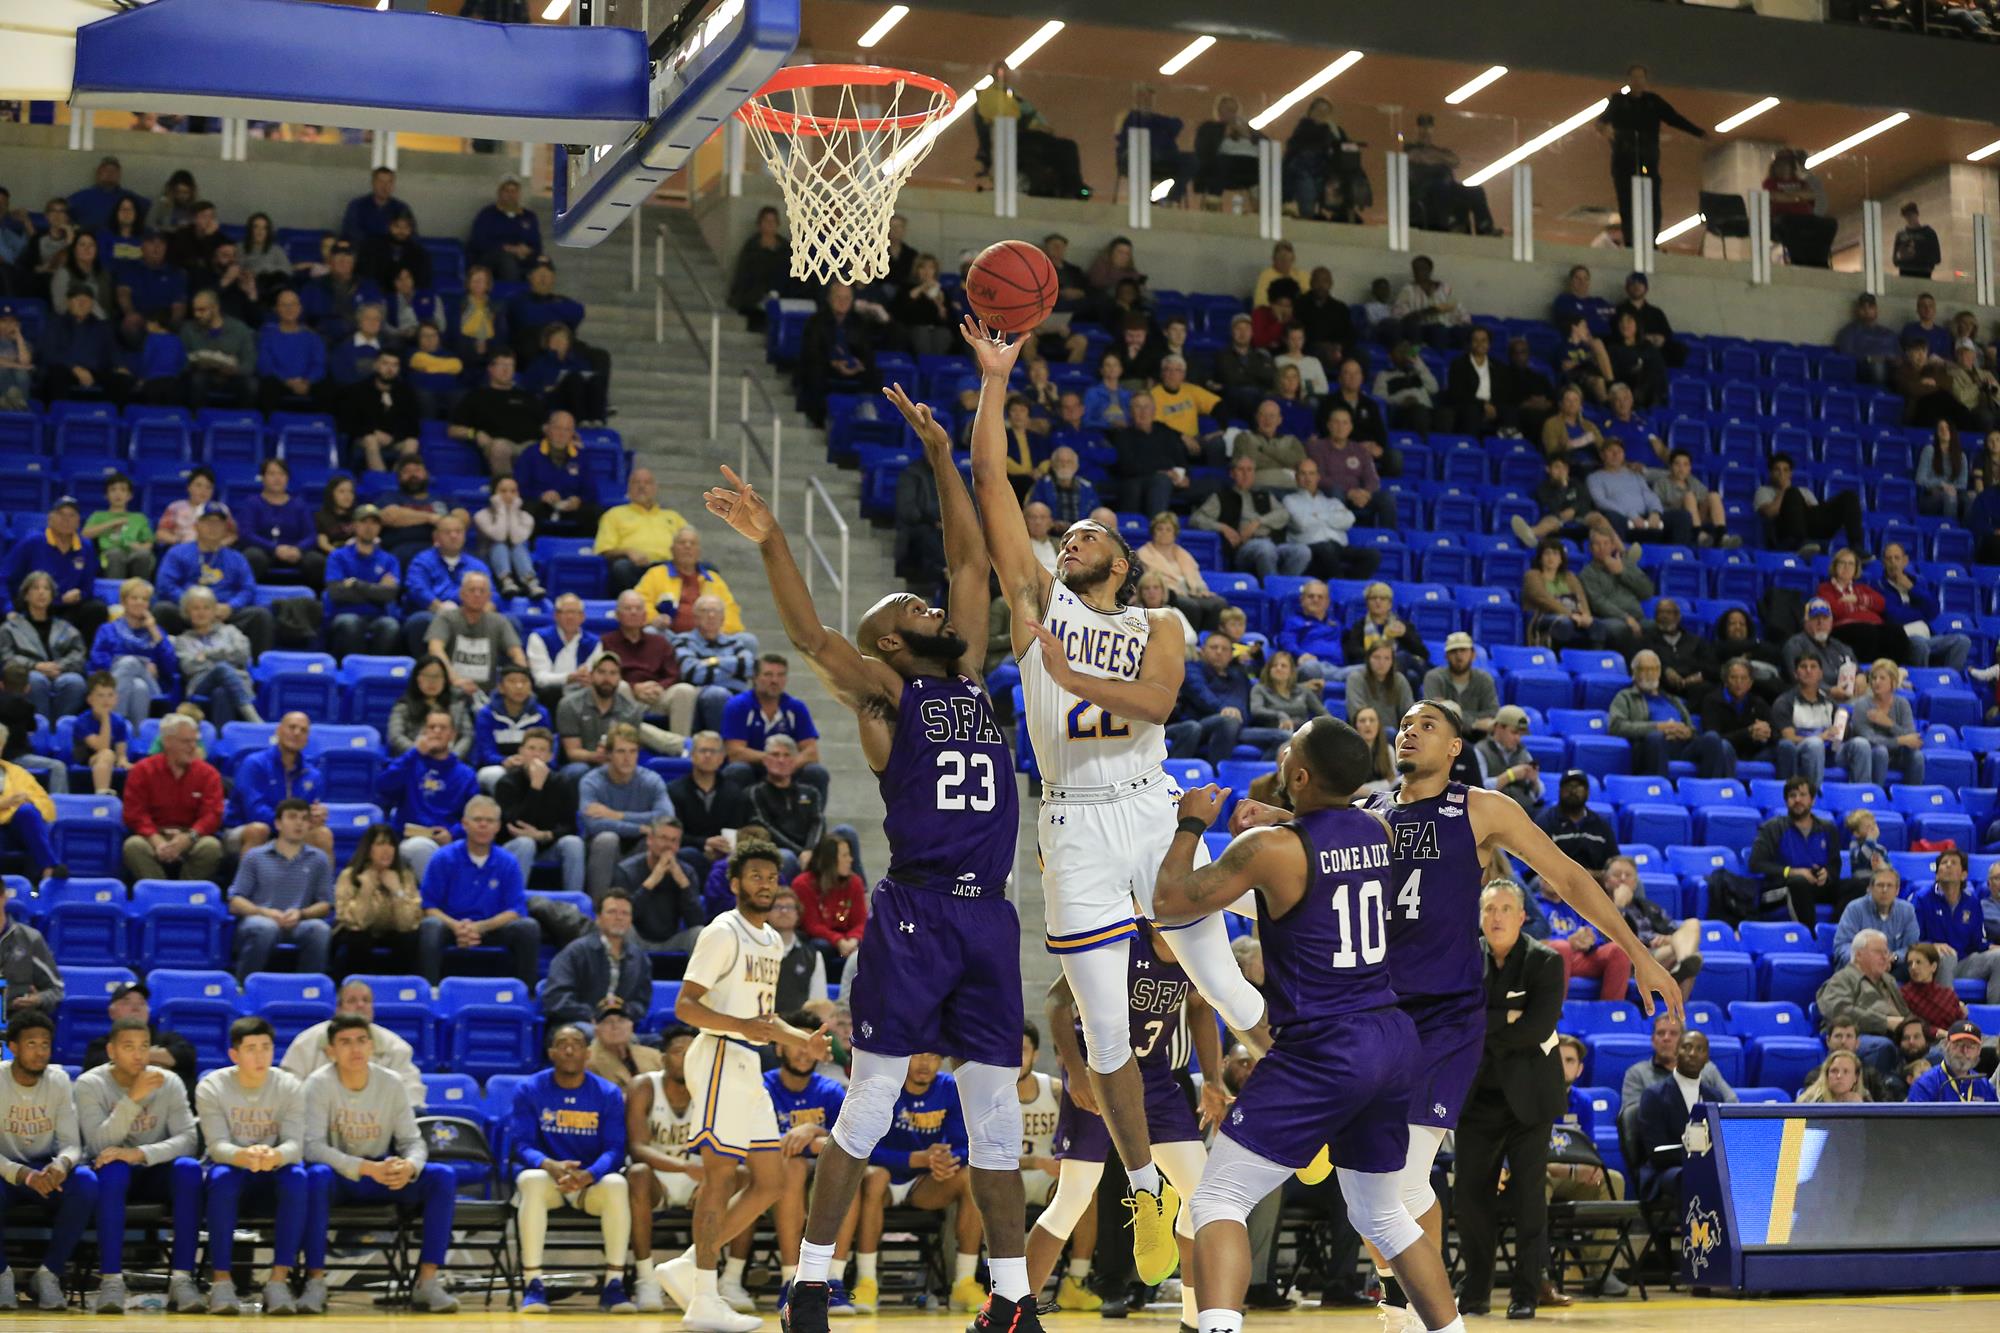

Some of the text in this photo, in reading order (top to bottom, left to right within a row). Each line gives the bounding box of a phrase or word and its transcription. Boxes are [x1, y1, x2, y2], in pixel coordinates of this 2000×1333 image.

[1050, 617, 1145, 681] McNEES
[920, 697, 1002, 744] SFA
[937, 751, 996, 811] 23
[1320, 843, 1390, 874] COMEAUX
[1393, 821, 1440, 860] FA
[952, 883, 982, 897] JACKS
[1385, 868, 1422, 921] 4
[1332, 879, 1387, 968] 10
[1130, 977, 1189, 1014] SFA
[1135, 1020, 1164, 1057] 3
[4, 1116, 52, 1136] LOADED
[9, 1104, 48, 1121] FULLY
[1024, 1112, 1055, 1136] EESE
